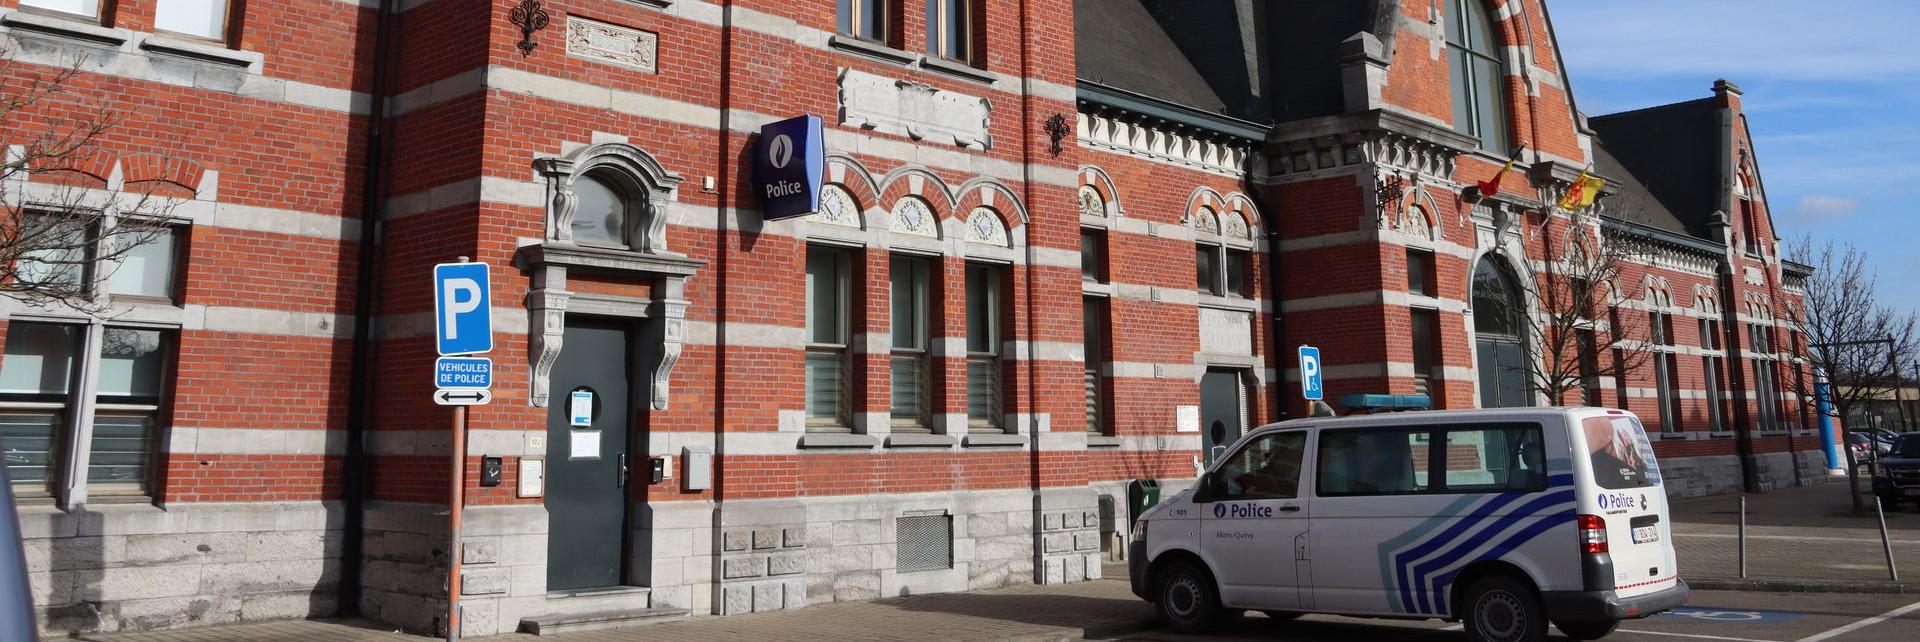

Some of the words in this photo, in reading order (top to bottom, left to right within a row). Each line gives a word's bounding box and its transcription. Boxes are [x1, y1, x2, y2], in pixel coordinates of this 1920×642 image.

[766, 180, 802, 199] Police
[443, 278, 482, 340] P
[439, 362, 488, 373] VEHICULES
[1302, 355, 1318, 391] P
[440, 373, 453, 383] DE
[454, 373, 486, 383] POLICE
[1609, 492, 1635, 508] Police
[1231, 503, 1273, 518] Police
